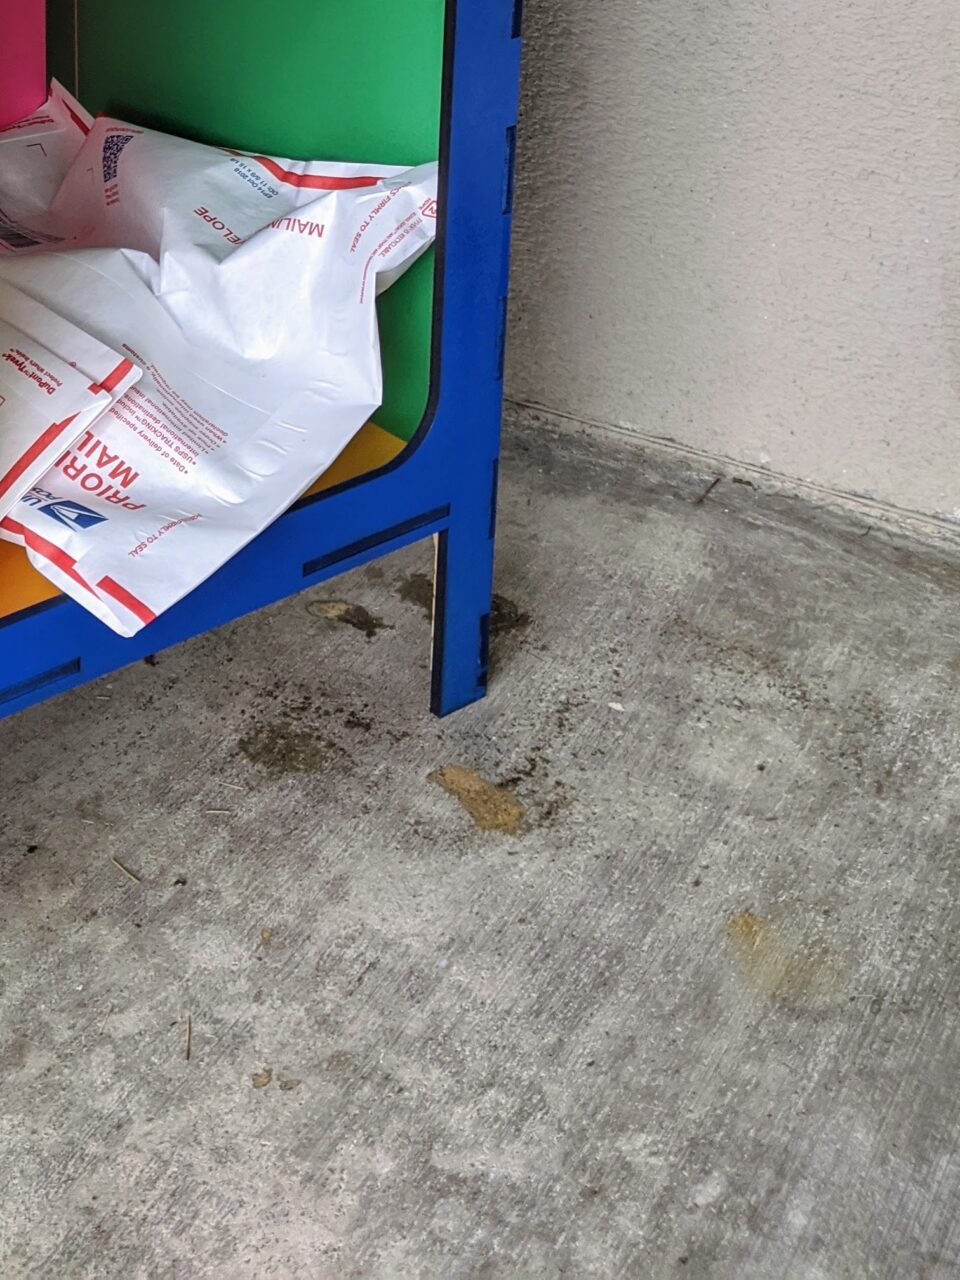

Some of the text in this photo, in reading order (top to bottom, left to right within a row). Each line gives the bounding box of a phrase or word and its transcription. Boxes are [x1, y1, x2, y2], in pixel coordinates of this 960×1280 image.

[234, 167, 249, 183] 2018
[248, 178, 258, 188] Oct
[350, 195, 393, 253] FIRMLY TO SEAL
[122, 343, 147, 365] customs
[108, 407, 139, 432] specified
[145, 400, 183, 432] international
[193, 410, 229, 437] declaration
[138, 429, 162, 453] delivery
[181, 431, 206, 452] Limited
[76, 430, 139, 489] MAIL
[169, 457, 186, 473] Date
[173, 445, 193, 463] USPS
[54, 450, 147, 511] PRIORI
[146, 532, 159, 544] TO
[128, 541, 148, 558] SEAL
